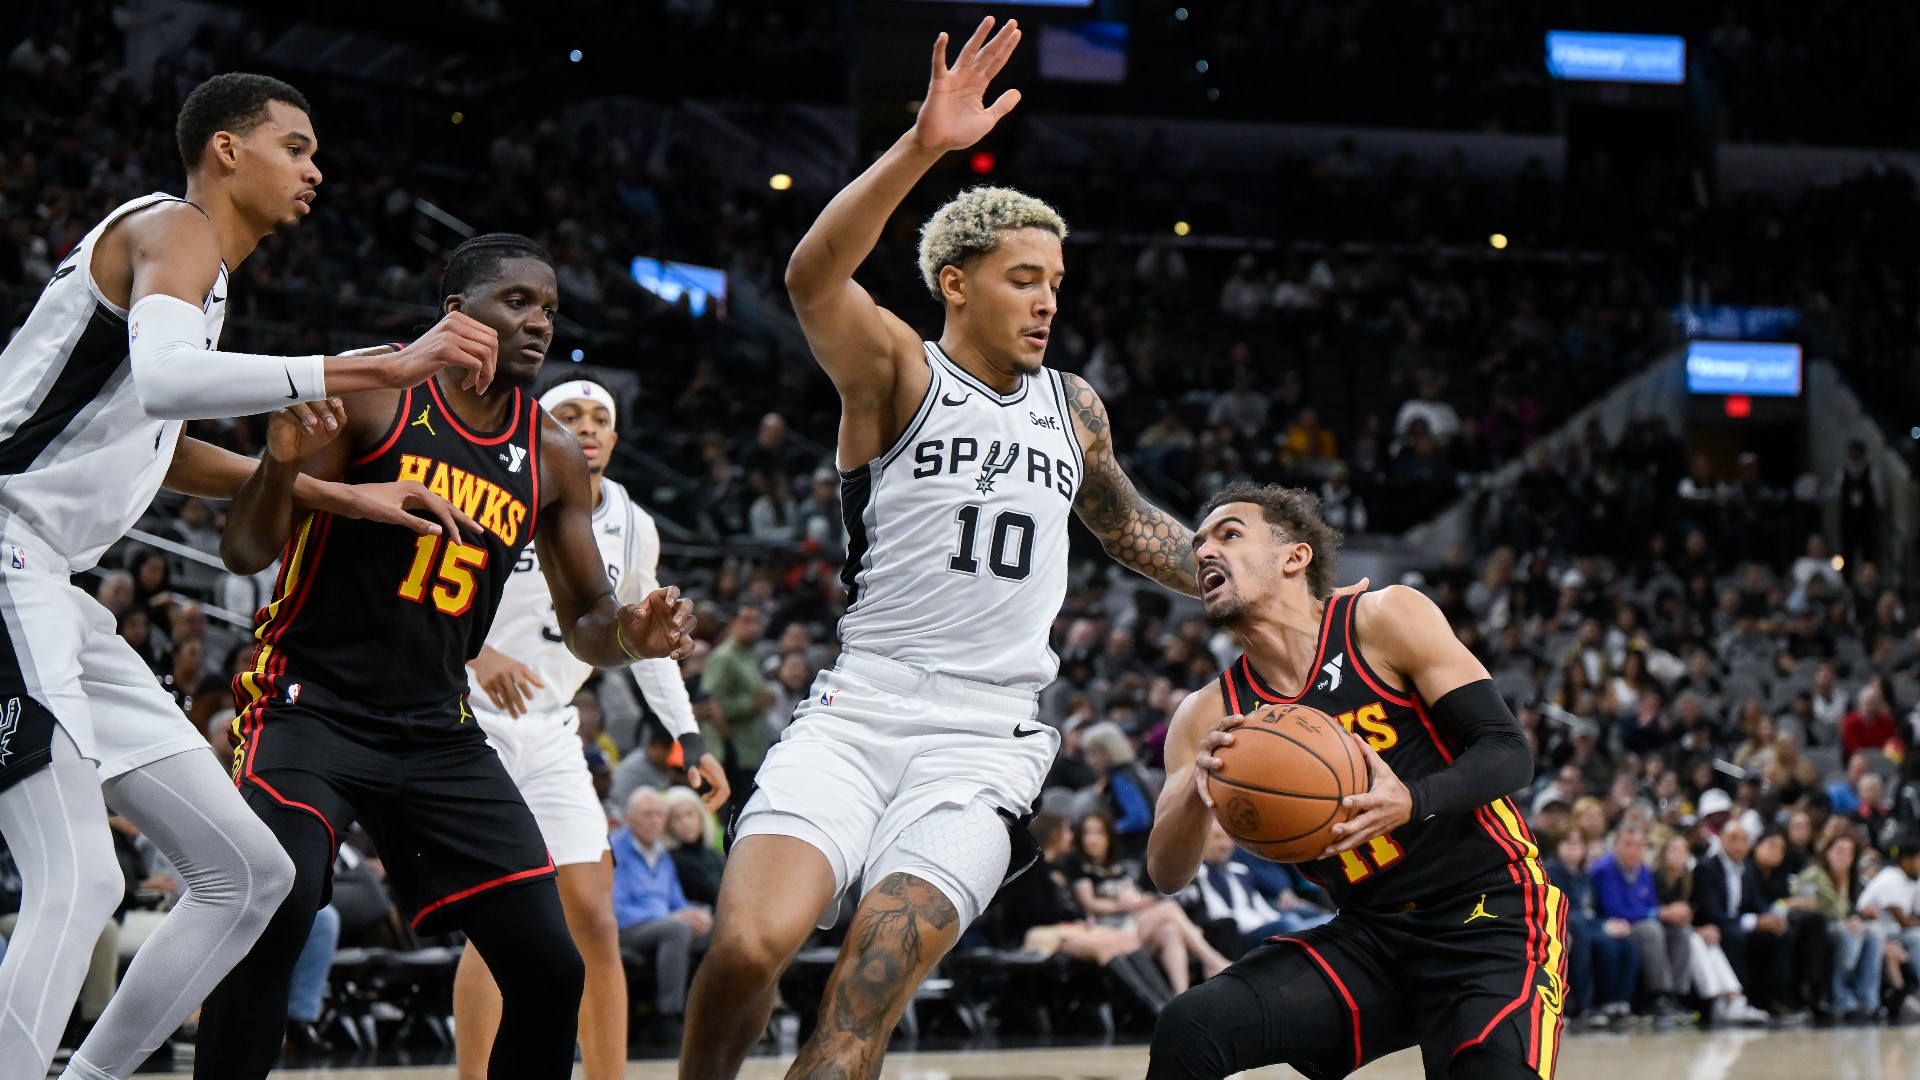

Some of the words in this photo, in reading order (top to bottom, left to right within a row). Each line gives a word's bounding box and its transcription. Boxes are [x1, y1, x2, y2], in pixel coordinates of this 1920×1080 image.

[1029, 411, 1061, 431] Self.
[397, 453, 528, 548] HAWKS
[913, 437, 1074, 502] SPURS
[397, 533, 489, 617] 15
[946, 503, 1038, 584] 10
[1317, 679, 1329, 690] the
